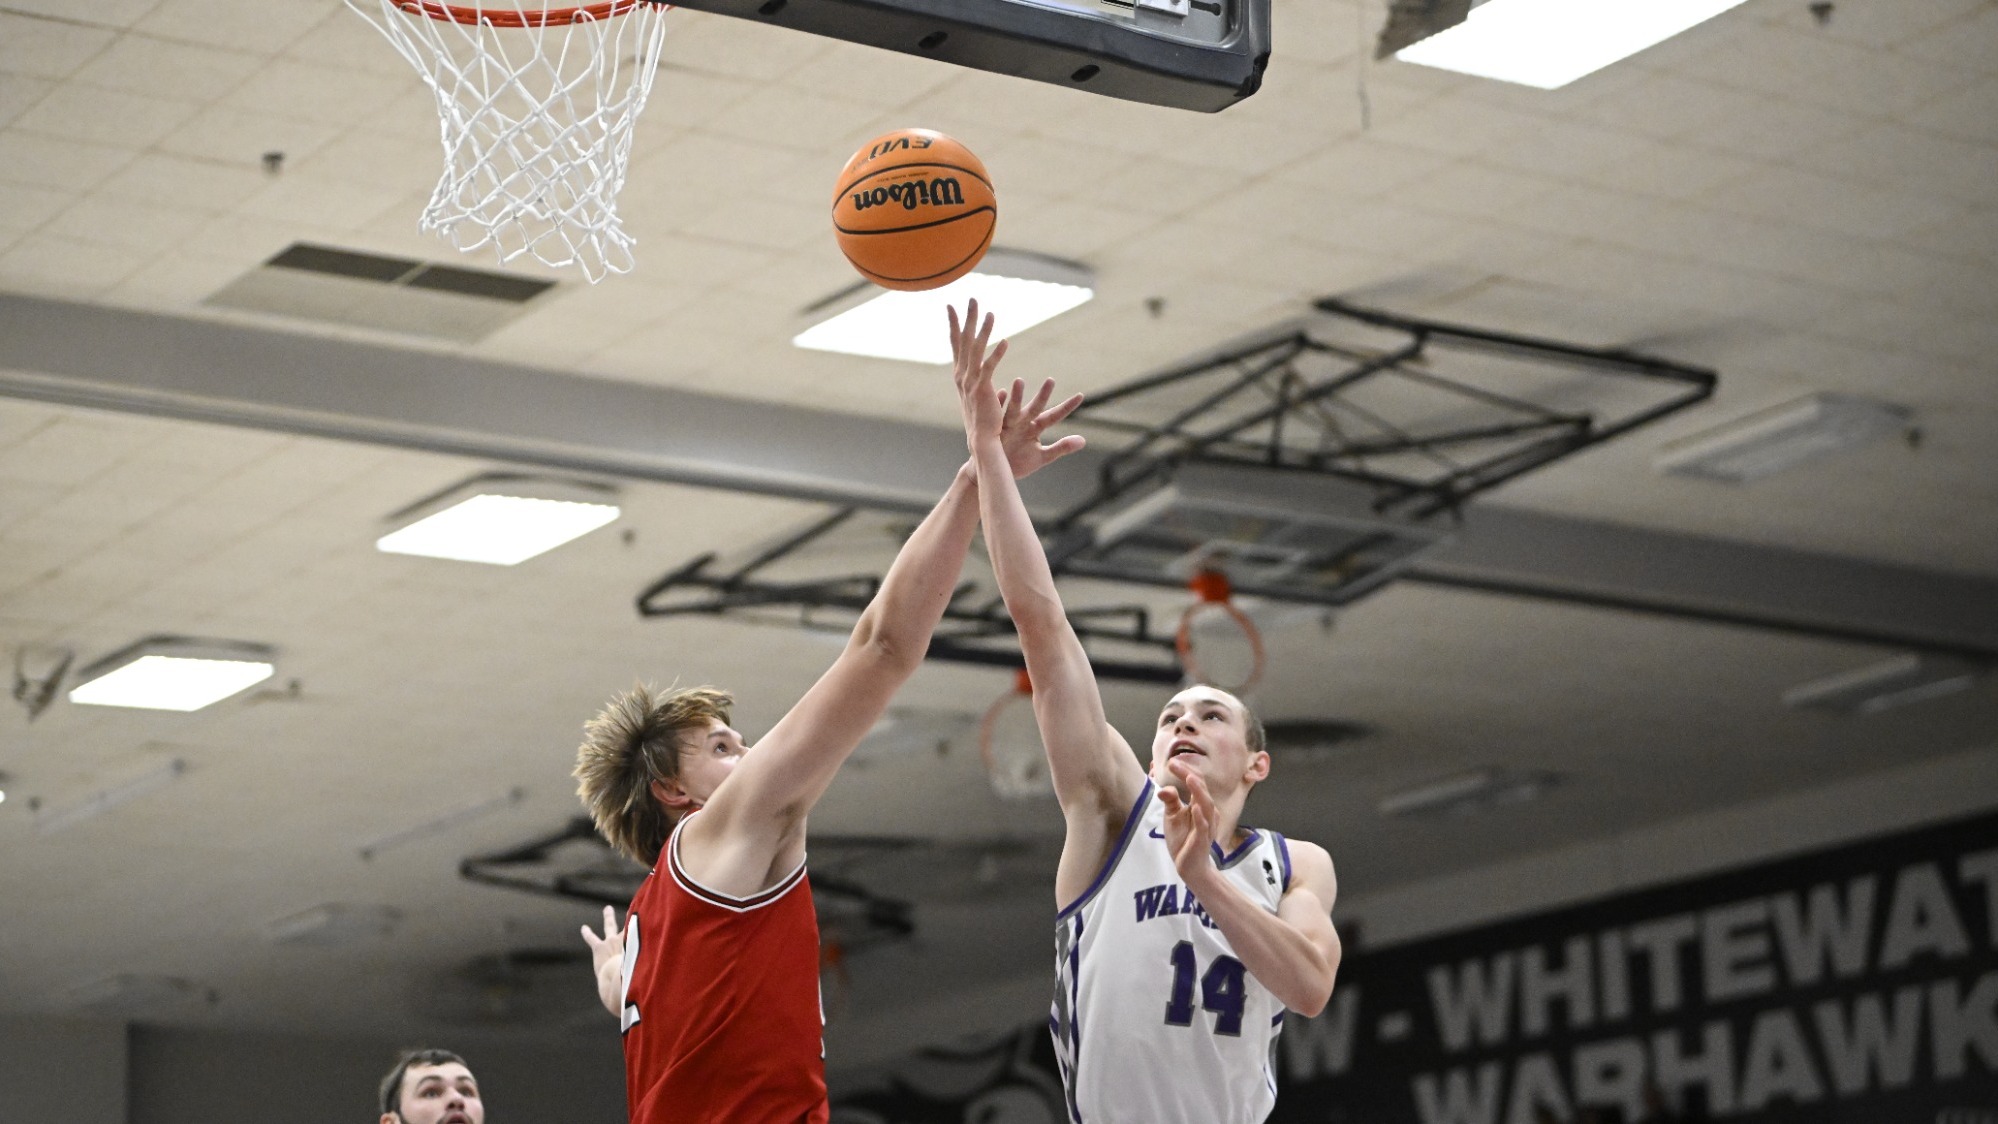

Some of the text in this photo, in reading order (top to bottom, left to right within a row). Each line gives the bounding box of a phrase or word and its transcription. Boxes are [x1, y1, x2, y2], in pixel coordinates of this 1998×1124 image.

[868, 136, 934, 160] EVO
[853, 178, 965, 211] Wilson
[1164, 939, 1248, 1038] 14
